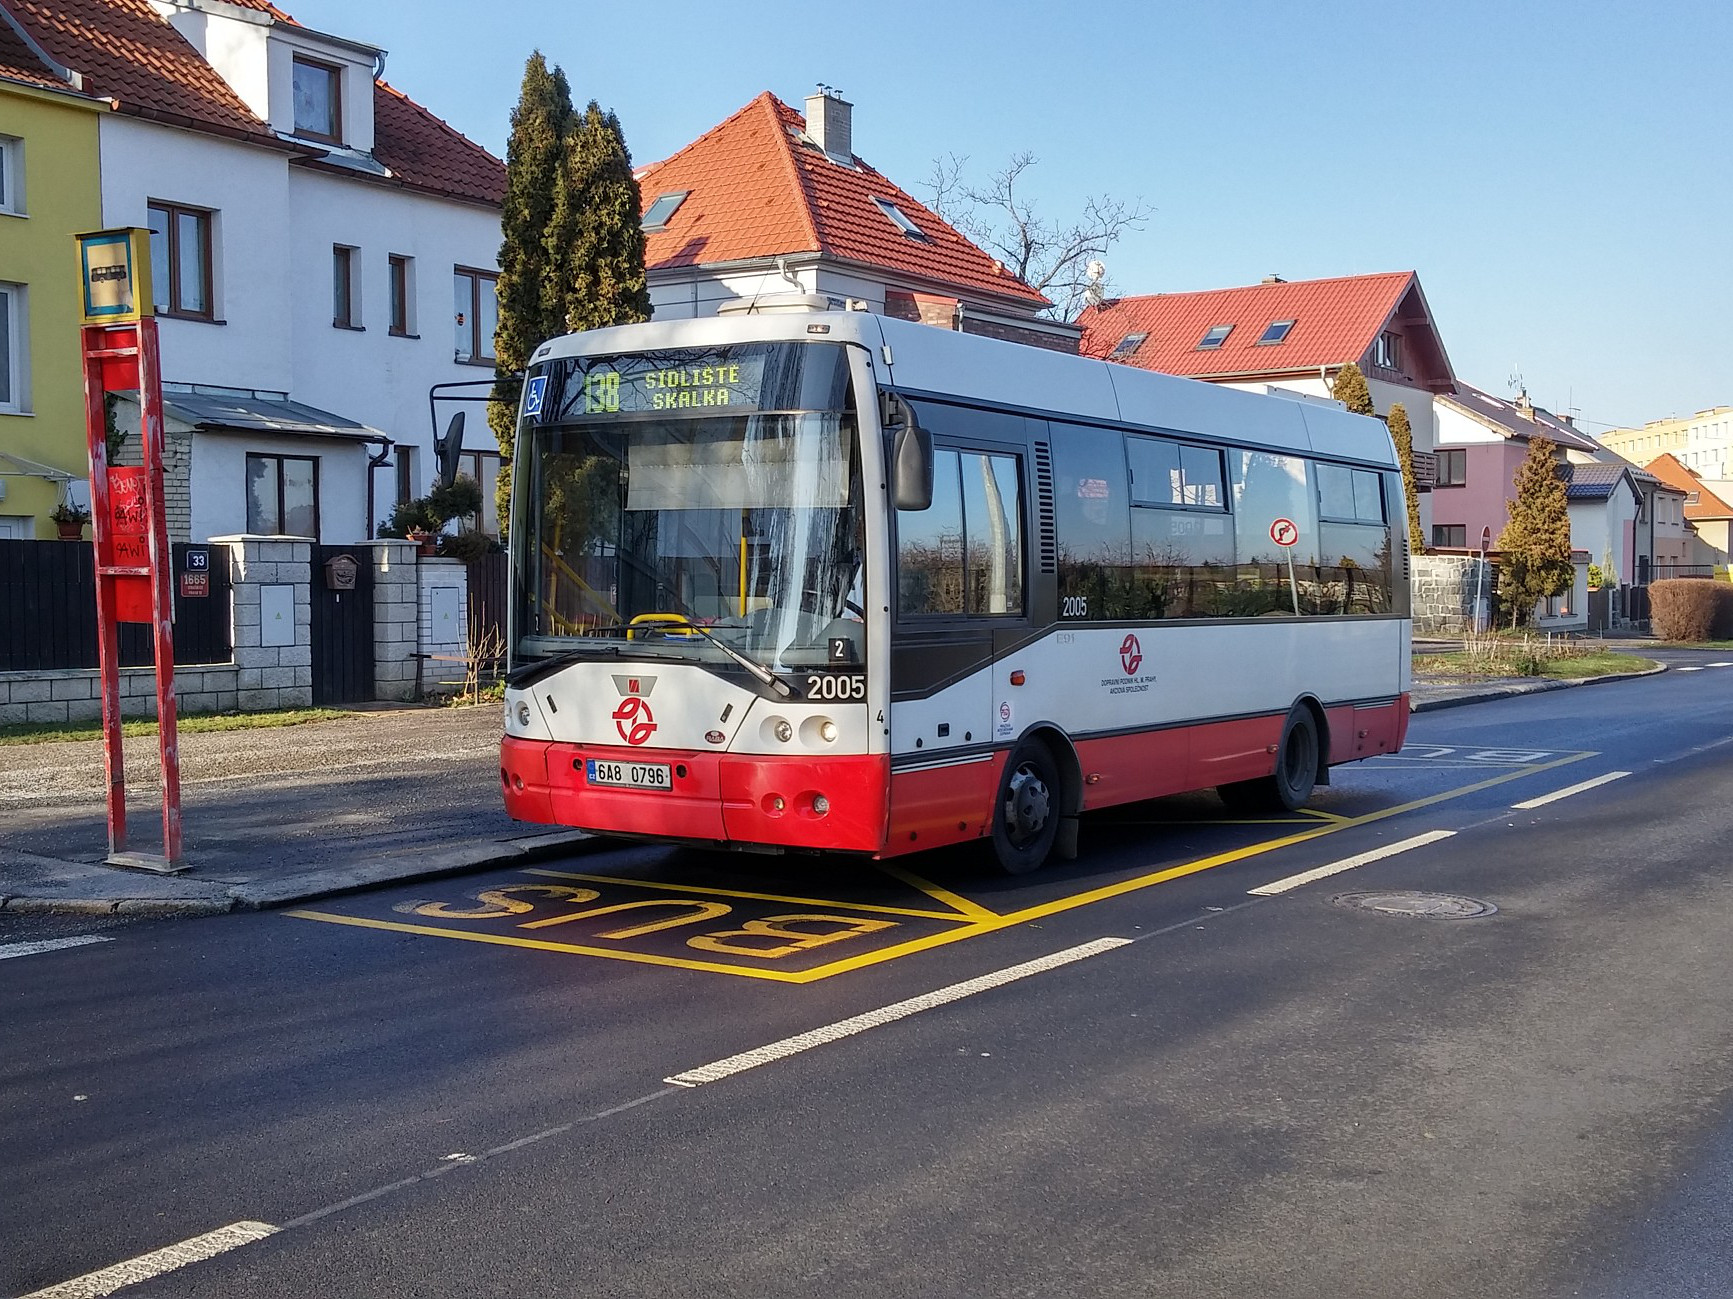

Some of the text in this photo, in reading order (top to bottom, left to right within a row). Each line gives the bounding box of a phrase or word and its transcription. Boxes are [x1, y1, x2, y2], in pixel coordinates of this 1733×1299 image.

[585, 372, 620, 414] 138
[652, 388, 729, 410] SKALKA
[192, 555, 205, 567] 33
[184, 574, 206, 585] 1665
[1062, 596, 1087, 617] 2005
[835, 640, 844, 657] 2
[807, 675, 865, 699] 2005
[876, 709, 885, 724] 4
[598, 764, 664, 784] 6A8 0796
[392, 883, 901, 959] BUS
